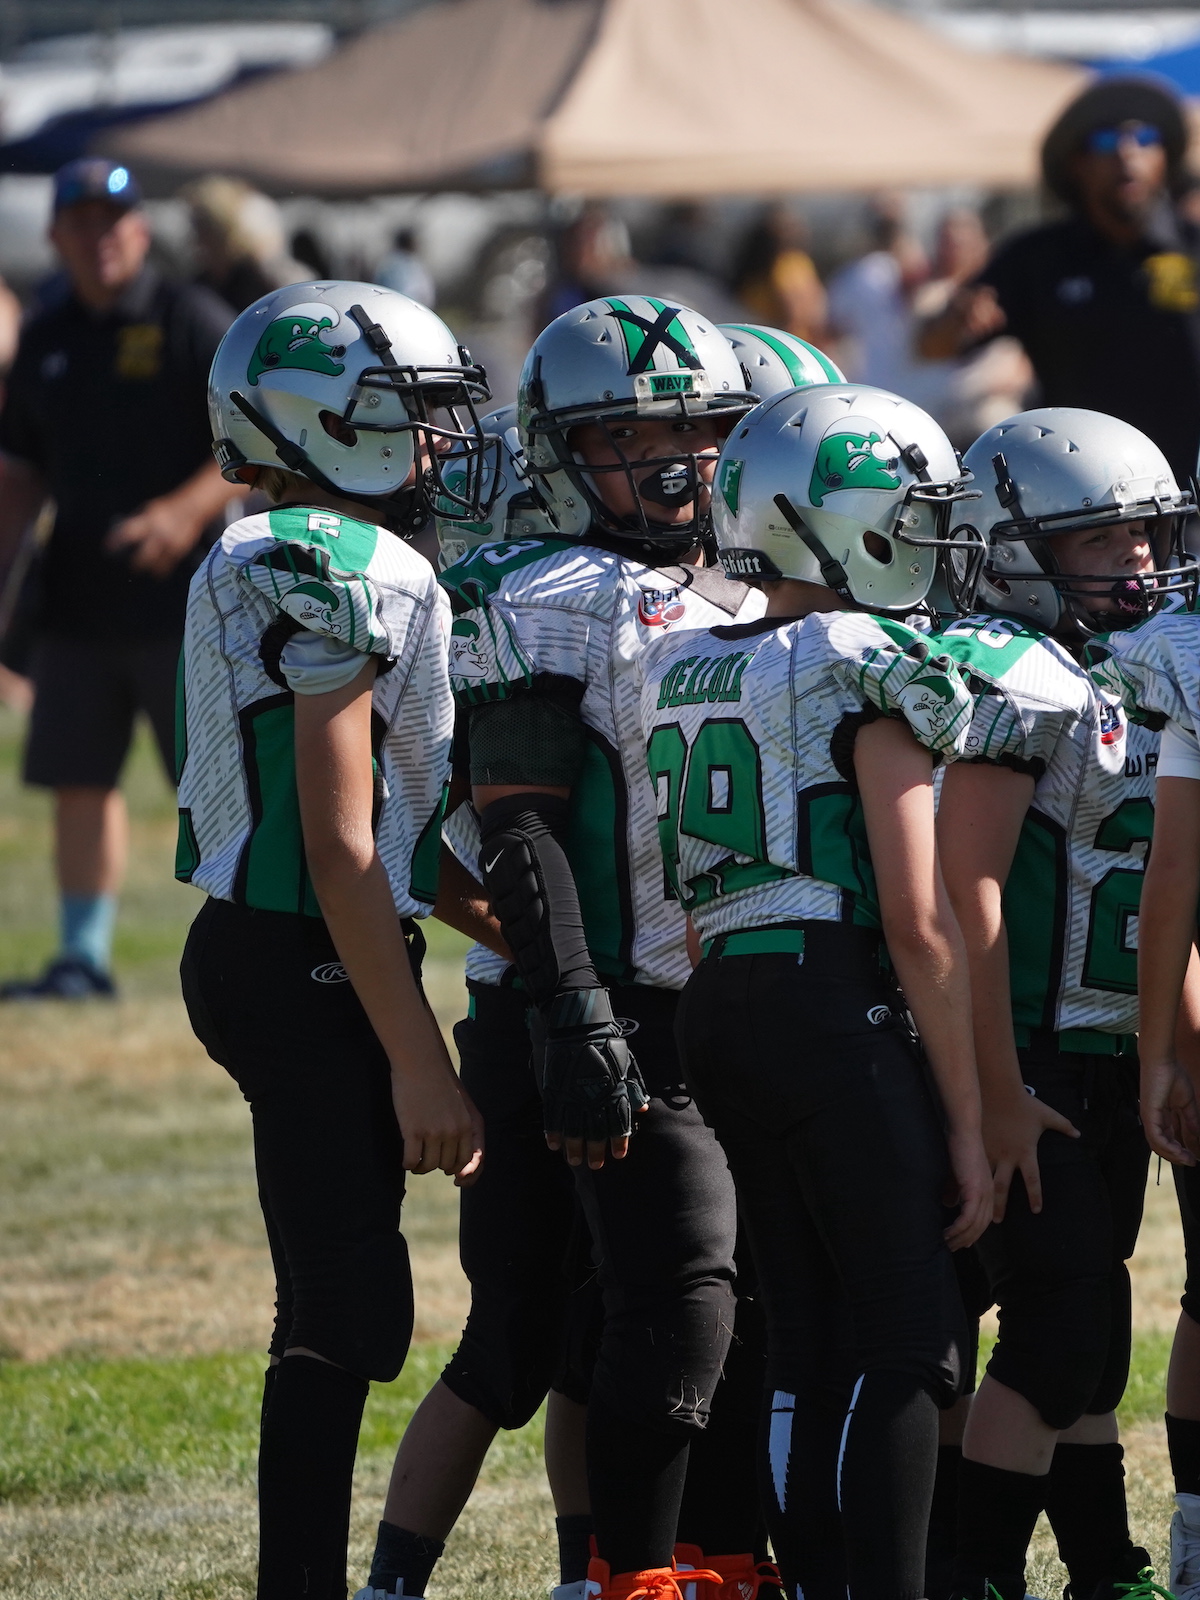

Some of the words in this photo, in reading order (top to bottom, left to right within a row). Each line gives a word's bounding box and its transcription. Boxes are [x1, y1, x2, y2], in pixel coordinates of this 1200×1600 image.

[652, 376, 693, 392] WAVE
[722, 465, 737, 493] F
[721, 554, 762, 574] chutt
